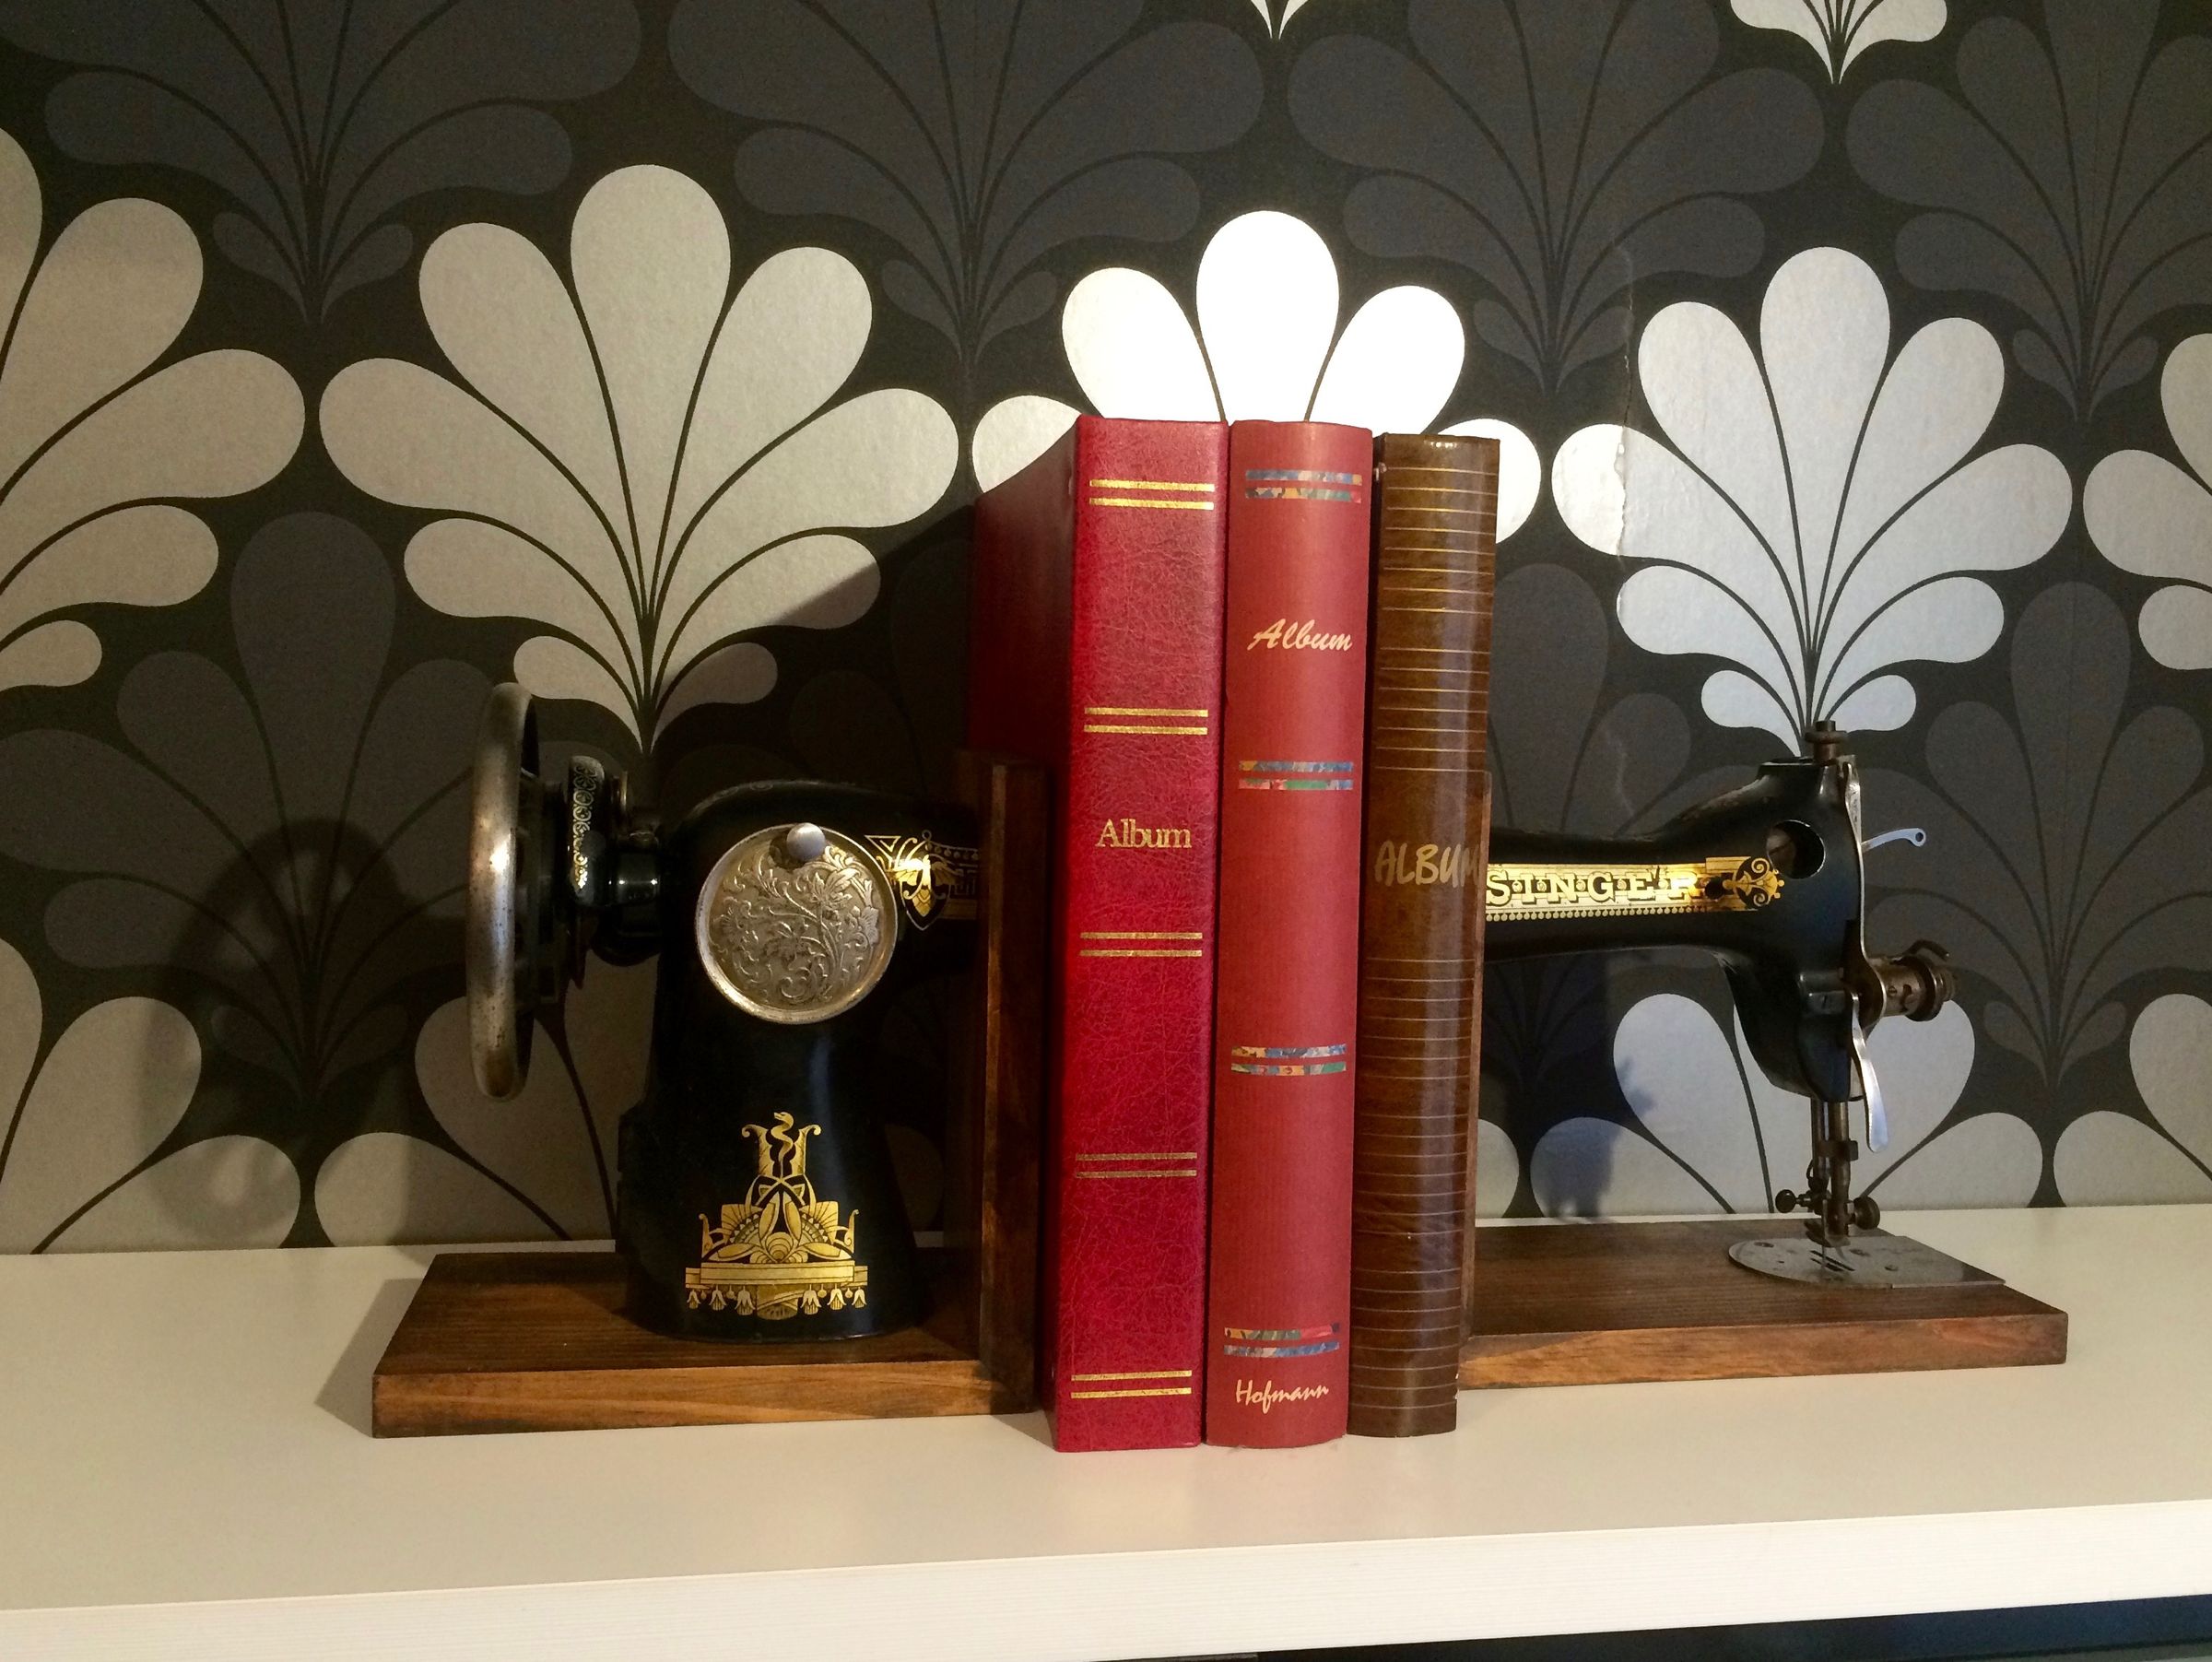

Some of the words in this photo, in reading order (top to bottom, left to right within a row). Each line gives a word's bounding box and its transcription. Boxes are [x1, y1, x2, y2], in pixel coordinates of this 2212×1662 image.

[1247, 618, 1353, 652] Album
[1095, 818, 1193, 850] Album
[1374, 840, 1479, 889] ALBUM
[1485, 867, 1703, 908] SINGER
[1235, 1378, 1330, 1414] Hofmann
